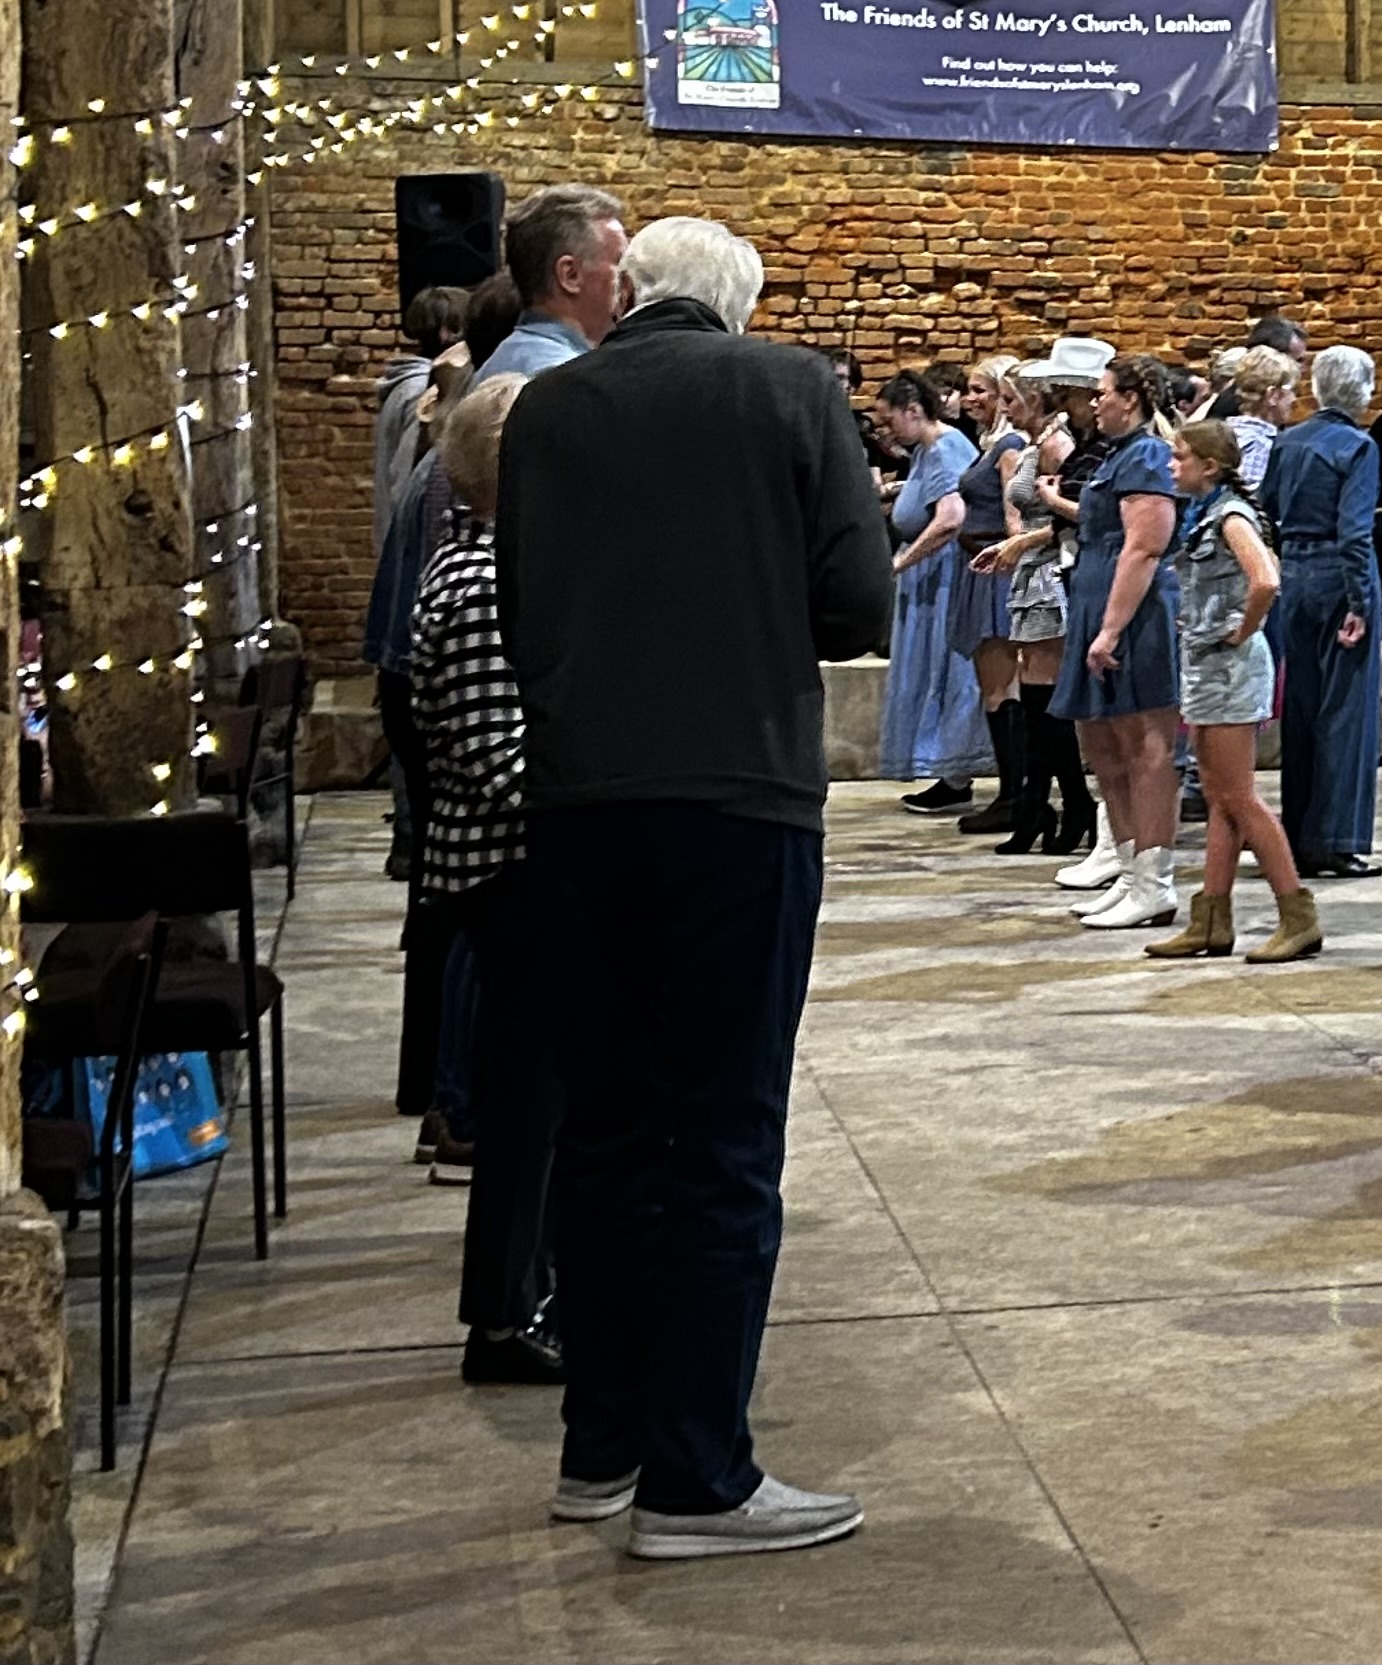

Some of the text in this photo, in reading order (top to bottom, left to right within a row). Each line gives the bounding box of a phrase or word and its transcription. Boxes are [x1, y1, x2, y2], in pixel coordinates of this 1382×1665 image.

[819, 2, 1232, 36] The Friends of St Mary's Church, Lenham
[941, 55, 972, 70] Find
[973, 60, 996, 72] out
[997, 57, 1028, 72] how
[1029, 62, 1056, 75] you
[1057, 63, 1084, 74] can
